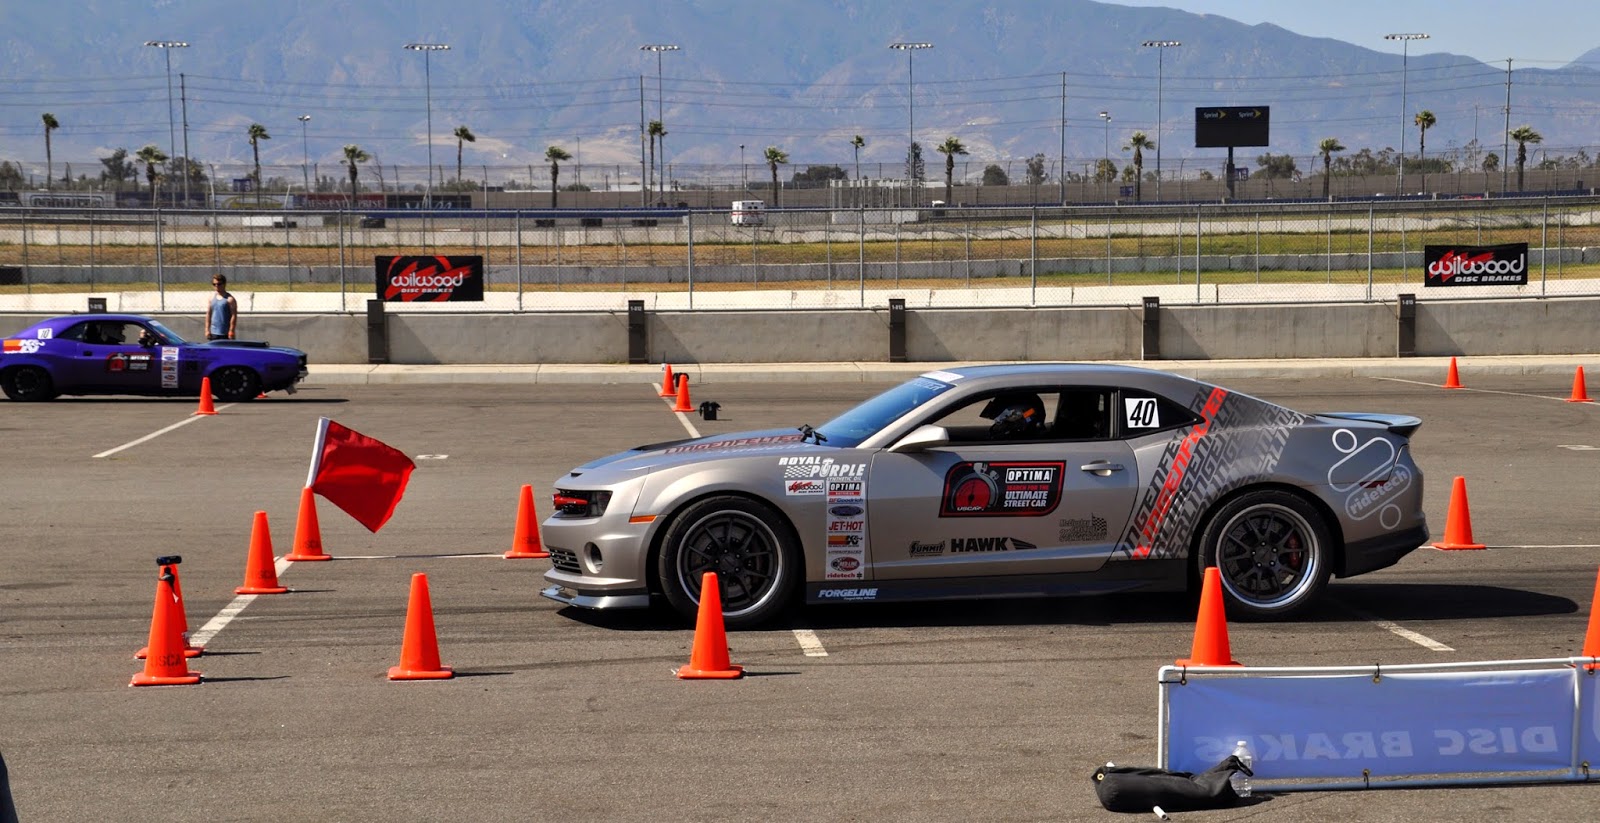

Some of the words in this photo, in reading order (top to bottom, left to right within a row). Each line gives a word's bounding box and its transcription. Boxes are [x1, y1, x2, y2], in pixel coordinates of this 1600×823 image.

[1428, 253, 1525, 275] wilwood
[391, 271, 464, 287] wilwood
[1129, 399, 1156, 427] 40
[778, 456, 821, 466] ROYAL
[809, 458, 867, 478] PURPLE
[1007, 470, 1051, 481] OPTIMA
[830, 483, 861, 491] OPTIMA
[1349, 469, 1409, 515] ridetech
[1005, 490, 1049, 500] ULTIMATE
[1003, 499, 1030, 508] STREET
[1030, 499, 1047, 508] CAR
[950, 537, 1009, 553] HAWK
[818, 588, 879, 598] FORGELINE
